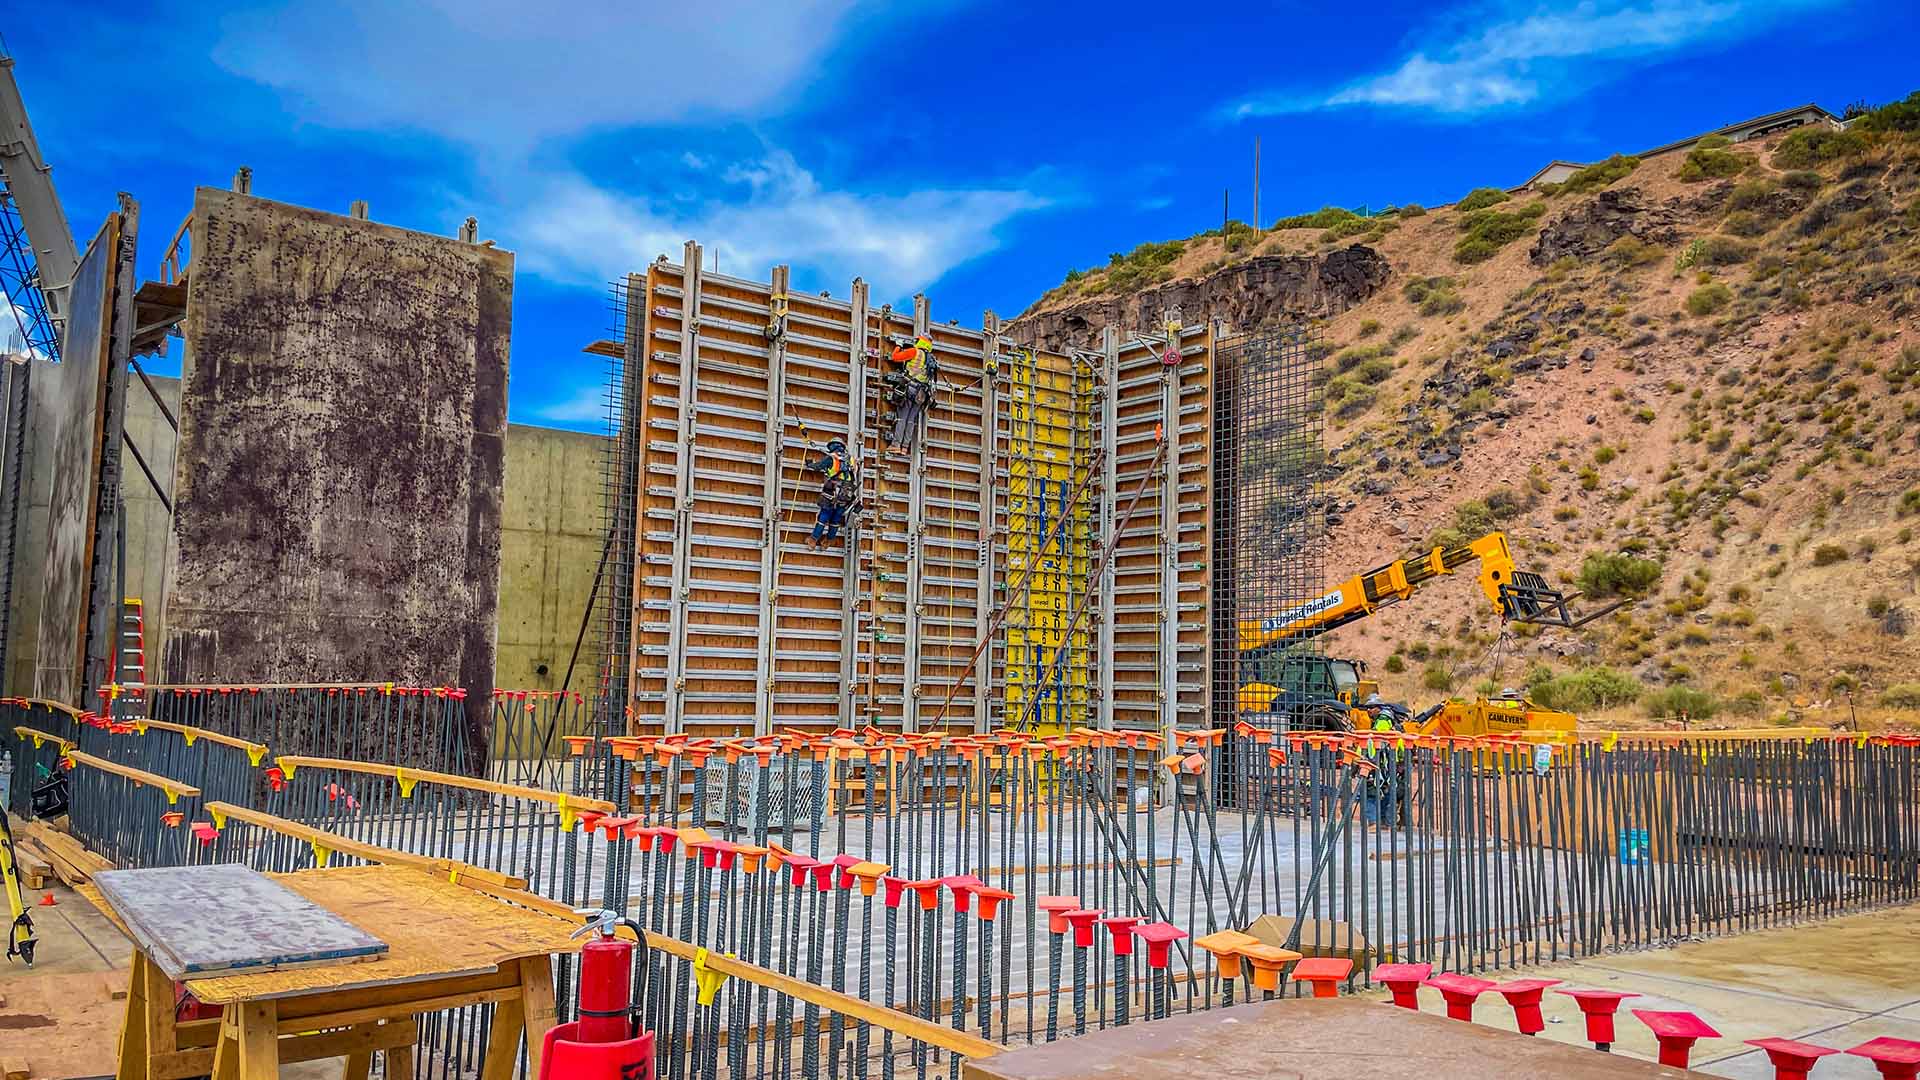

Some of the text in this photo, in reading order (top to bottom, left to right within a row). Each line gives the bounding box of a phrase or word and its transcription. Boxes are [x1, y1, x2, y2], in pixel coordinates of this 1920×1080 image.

[1052, 597, 1061, 641] doka
[1276, 595, 1339, 625] United Rentals
